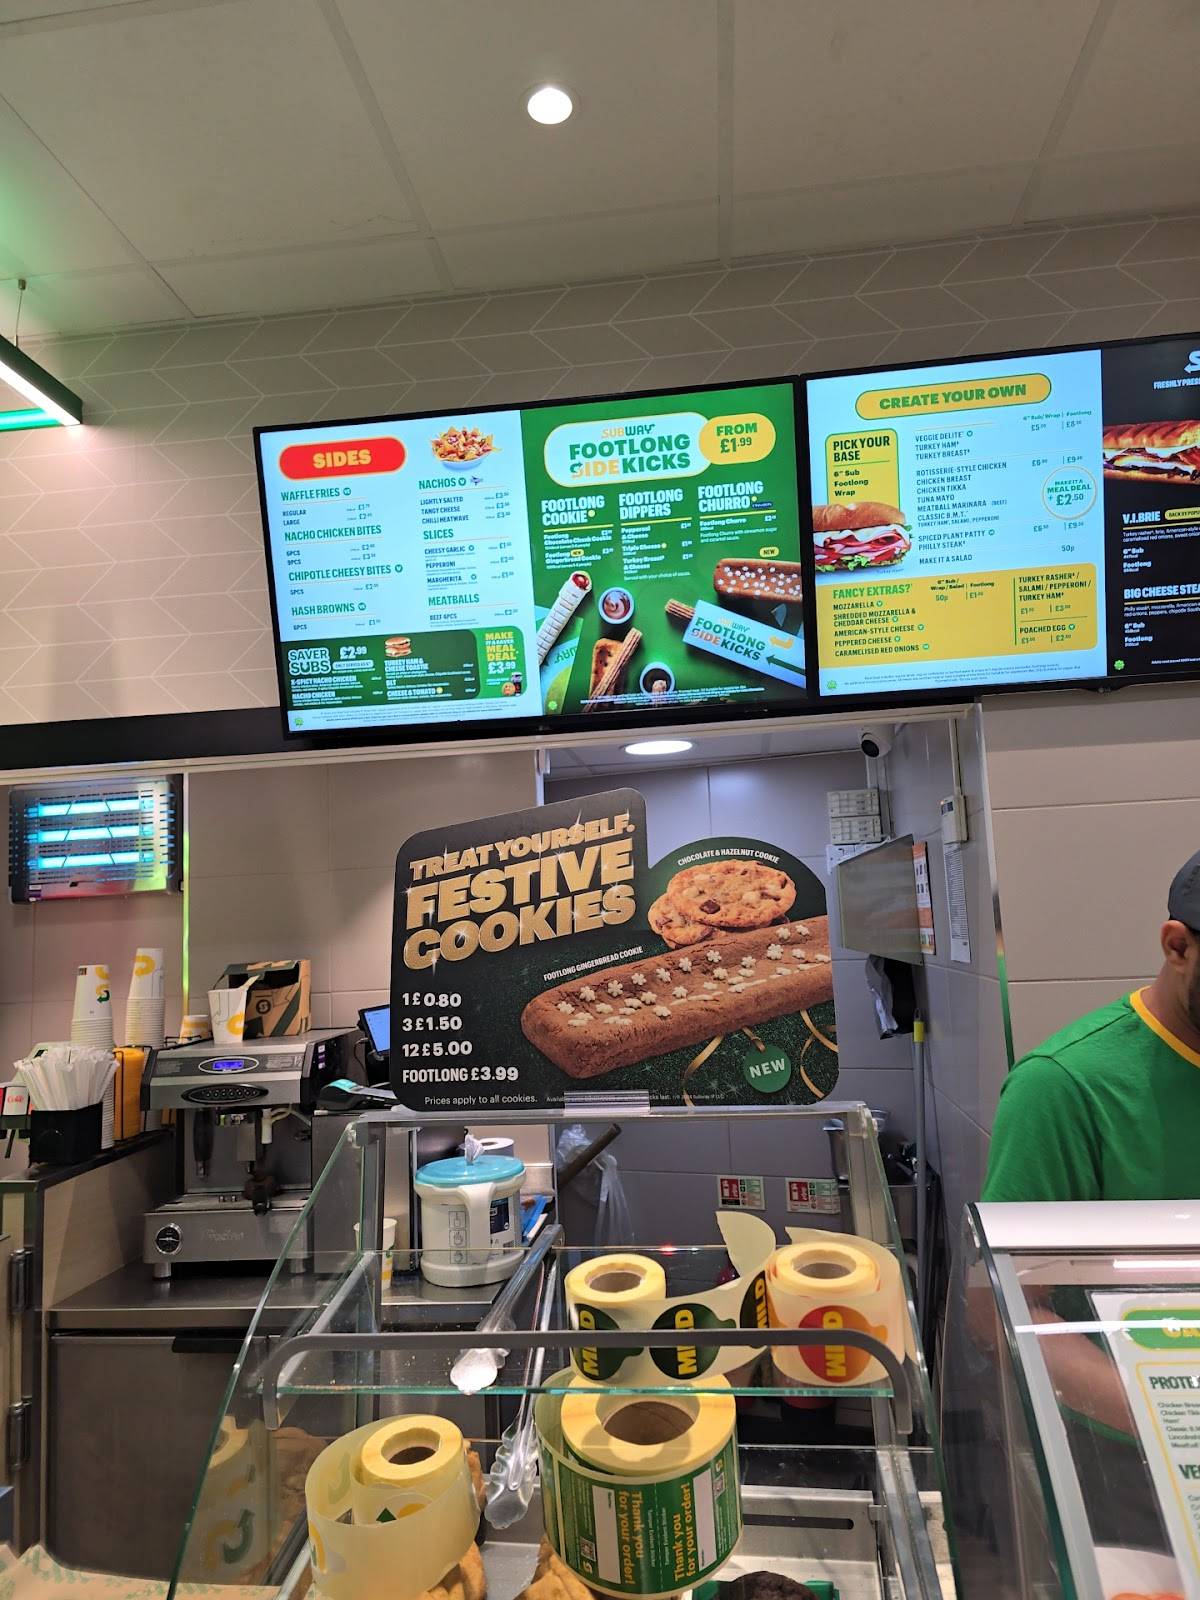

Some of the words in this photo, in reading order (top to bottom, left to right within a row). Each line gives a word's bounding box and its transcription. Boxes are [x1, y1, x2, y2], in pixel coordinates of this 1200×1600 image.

[1154, 379, 1181, 389] FRESHLY
[880, 394, 939, 410] CREATE
[942, 389, 985, 403] YOUR
[988, 384, 1026, 399] OWN
[601, 424, 655, 439] SUBWAY
[717, 423, 757, 436] FROM
[833, 439, 859, 450] PICK
[859, 435, 890, 449] YOUR
[916, 433, 939, 442] VEGGIE
[569, 434, 690, 460] FOOTLONG
[720, 437, 752, 453] £1.99
[916, 443, 941, 451] TURKEY
[313, 449, 371, 469] SIDES
[833, 451, 860, 462] BASE
[916, 452, 941, 461] TURKEY
[845, 468, 860, 476] Sub
[917, 464, 976, 476] ROTISSERIE-STYLE
[978, 462, 1007, 471] CHICKEN
[419, 478, 456, 489] NACHOS
[834, 478, 868, 488] Footlong
[917, 477, 945, 485] CHICKEN
[947, 475, 971, 483] BREAST
[281, 489, 316, 501] WAFFLE
[316, 488, 340, 499] FRIES
[698, 481, 763, 499] FOOTLONG
[835, 488, 855, 497] Wrap
[917, 486, 945, 494] CHICKEN
[947, 484, 966, 492] TIKKA
[420, 497, 442, 505] LIGHTLY
[541, 495, 605, 512] FOOTLONG
[619, 488, 683, 506] FOOTLONG
[918, 495, 935, 503] TUNA
[936, 494, 954, 502] MAYO
[1056, 493, 1084, 505] £2.50
[699, 496, 750, 512] CHURRO
[918, 503, 950, 512] MEATBALL
[952, 500, 986, 509] MARINARA
[620, 502, 671, 520] DIPPERS
[918, 513, 945, 521] CLASSIC
[1123, 511, 1161, 524] V.I.BRIE
[543, 510, 588, 526] COOKIE
[285, 530, 315, 541] NACHO
[317, 527, 355, 538] CHICKEN
[357, 525, 381, 536] BITES
[423, 529, 454, 540] SLICES
[919, 534, 942, 542] SPICED
[943, 532, 964, 540] PLANT
[965, 530, 985, 538] PATTY
[919, 542, 940, 550] PHILLY
[951, 554, 972, 562] SALAD
[289, 569, 331, 581] CHIPOTLE
[332, 567, 365, 578] CHEESY
[367, 565, 391, 575] BITES
[1050, 581, 1086, 589] PEPPERONI
[833, 588, 864, 599] FANCY
[1124, 588, 1141, 599] BIG
[1142, 585, 1179, 598] CHEESE
[429, 594, 479, 606] MEATBALLS
[833, 602, 874, 610] MOZZARELLA
[292, 605, 315, 616] HASH
[317, 603, 355, 614] BROWNS
[834, 612, 867, 620] SHREDDED
[869, 609, 909, 617] MOZZARELLA
[834, 619, 864, 627] CHEDDAR
[486, 632, 513, 640] MAKE
[695, 617, 766, 651] FOOTLONG
[835, 627, 888, 637] AMERICAN-STYLE
[1020, 626, 1051, 634] POACHED
[486, 645, 515, 653] MEAL
[835, 639, 866, 647] PEPPERED
[290, 649, 328, 660] SAVER
[835, 648, 879, 656] CARAMELISED
[290, 661, 330, 673] SUBS
[409, 845, 495, 882] TREAT
[495, 813, 635, 862] YOURSELF.
[677, 850, 715, 866] CHOCOLATE
[721, 848, 754, 856] HAZELNUT
[754, 851, 780, 863] COOKIE
[405, 838, 635, 931] FESTIVE
[403, 884, 637, 971] COOKIES
[543, 966, 576, 982] FOOTLONG
[576, 953, 619, 972] GINGERBREAD
[619, 946, 643, 960] COOKIE
[403, 1068, 468, 1083] FOOTLONG
[471, 1066, 519, 1081] £3.99
[750, 1059, 785, 1078] NEW
[425, 1096, 450, 1105] Prices
[452, 1096, 476, 1106] apply
[489, 1095, 500, 1103] all
[502, 1094, 538, 1103] cookies.
[580, 1310, 599, 1376] MID
[675, 1309, 697, 1375] MID
[823, 1311, 847, 1377] MID
[619, 1491, 629, 1510] for
[631, 1490, 644, 1532] Thank
[618, 1514, 630, 1542] your
[673, 1514, 683, 1538] you
[632, 1535, 644, 1558] you
[686, 1526, 696, 1554] your
[673, 1541, 685, 1581] Thank
[687, 1558, 696, 1576] for
